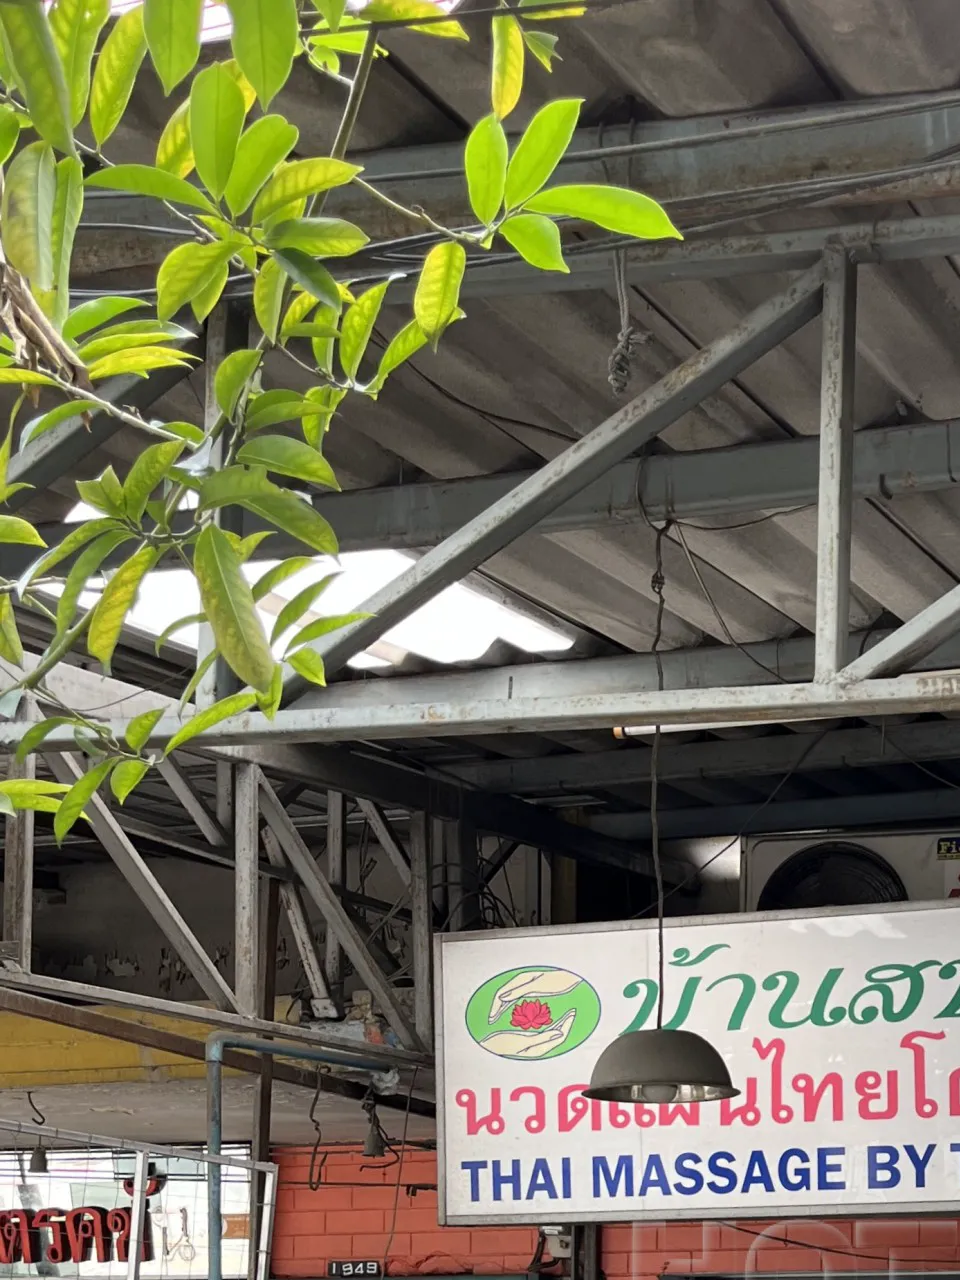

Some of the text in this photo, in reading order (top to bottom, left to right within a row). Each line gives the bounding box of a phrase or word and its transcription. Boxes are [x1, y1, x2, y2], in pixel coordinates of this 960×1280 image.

[461, 1157, 571, 1201] THAI
[592, 1147, 846, 1198] MASSAGE
[867, 1144, 936, 1190] BY
[331, 1262, 378, 1277] 1949
